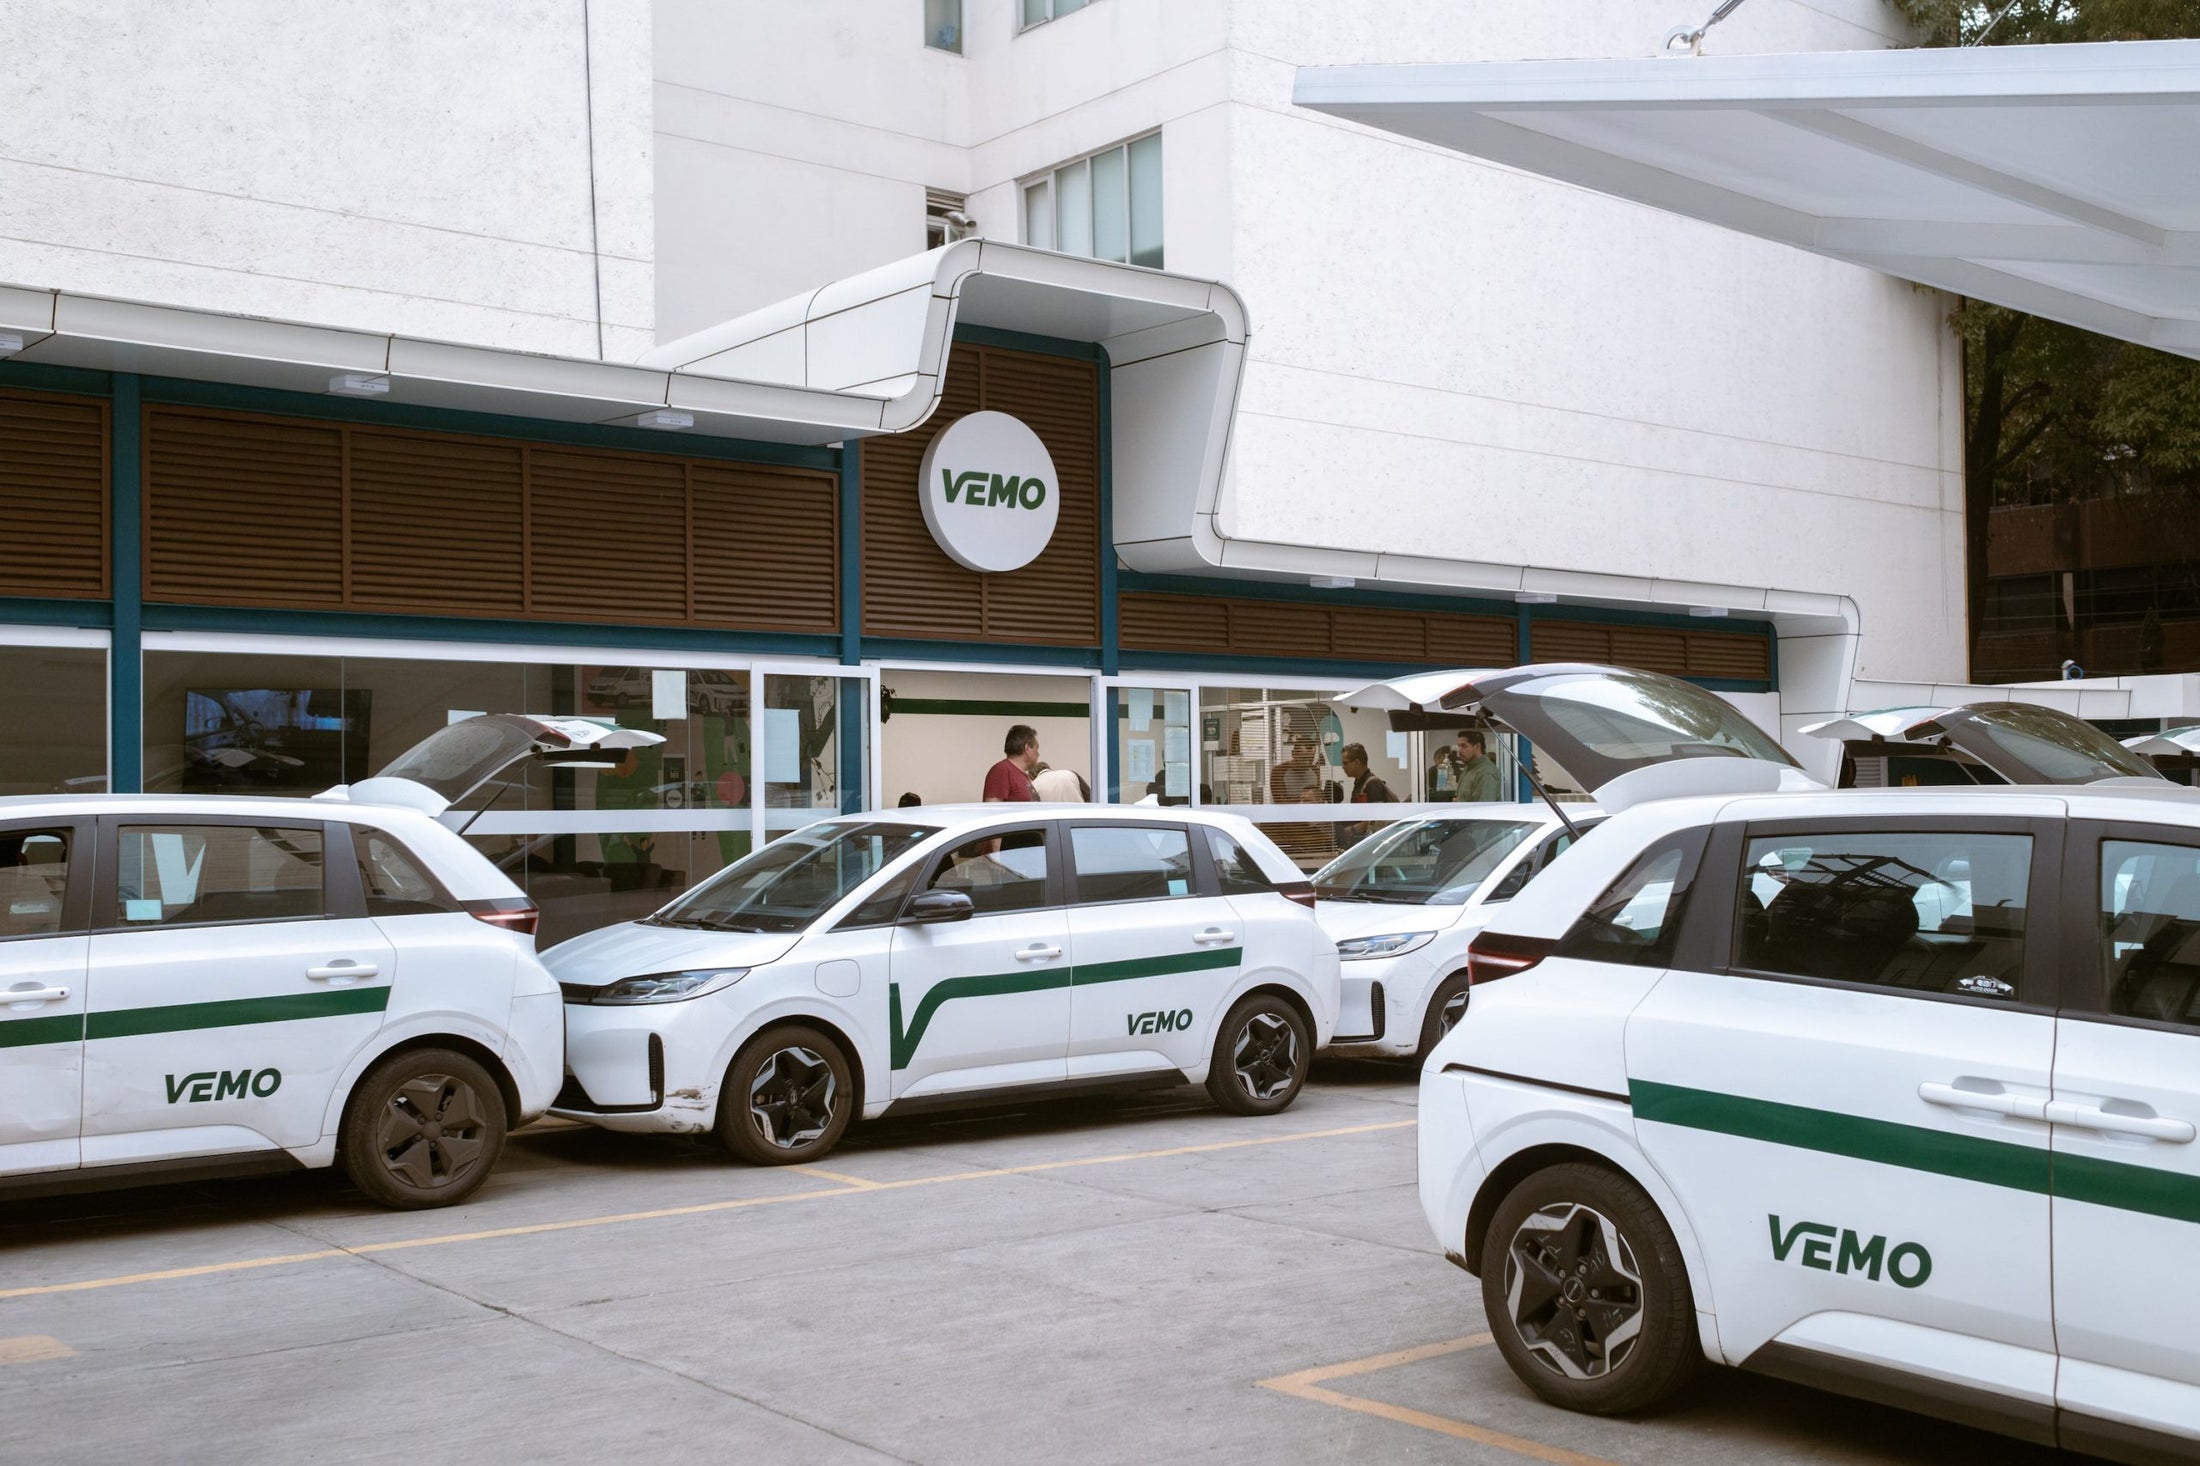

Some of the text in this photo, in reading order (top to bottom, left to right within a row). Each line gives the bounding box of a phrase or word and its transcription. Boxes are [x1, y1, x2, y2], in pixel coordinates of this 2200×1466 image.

[942, 468, 1046, 511] VEMO
[1127, 1008, 1193, 1036] VEMO
[165, 1067, 282, 1104] VEMO
[1768, 1213, 1932, 1288] VEMO
